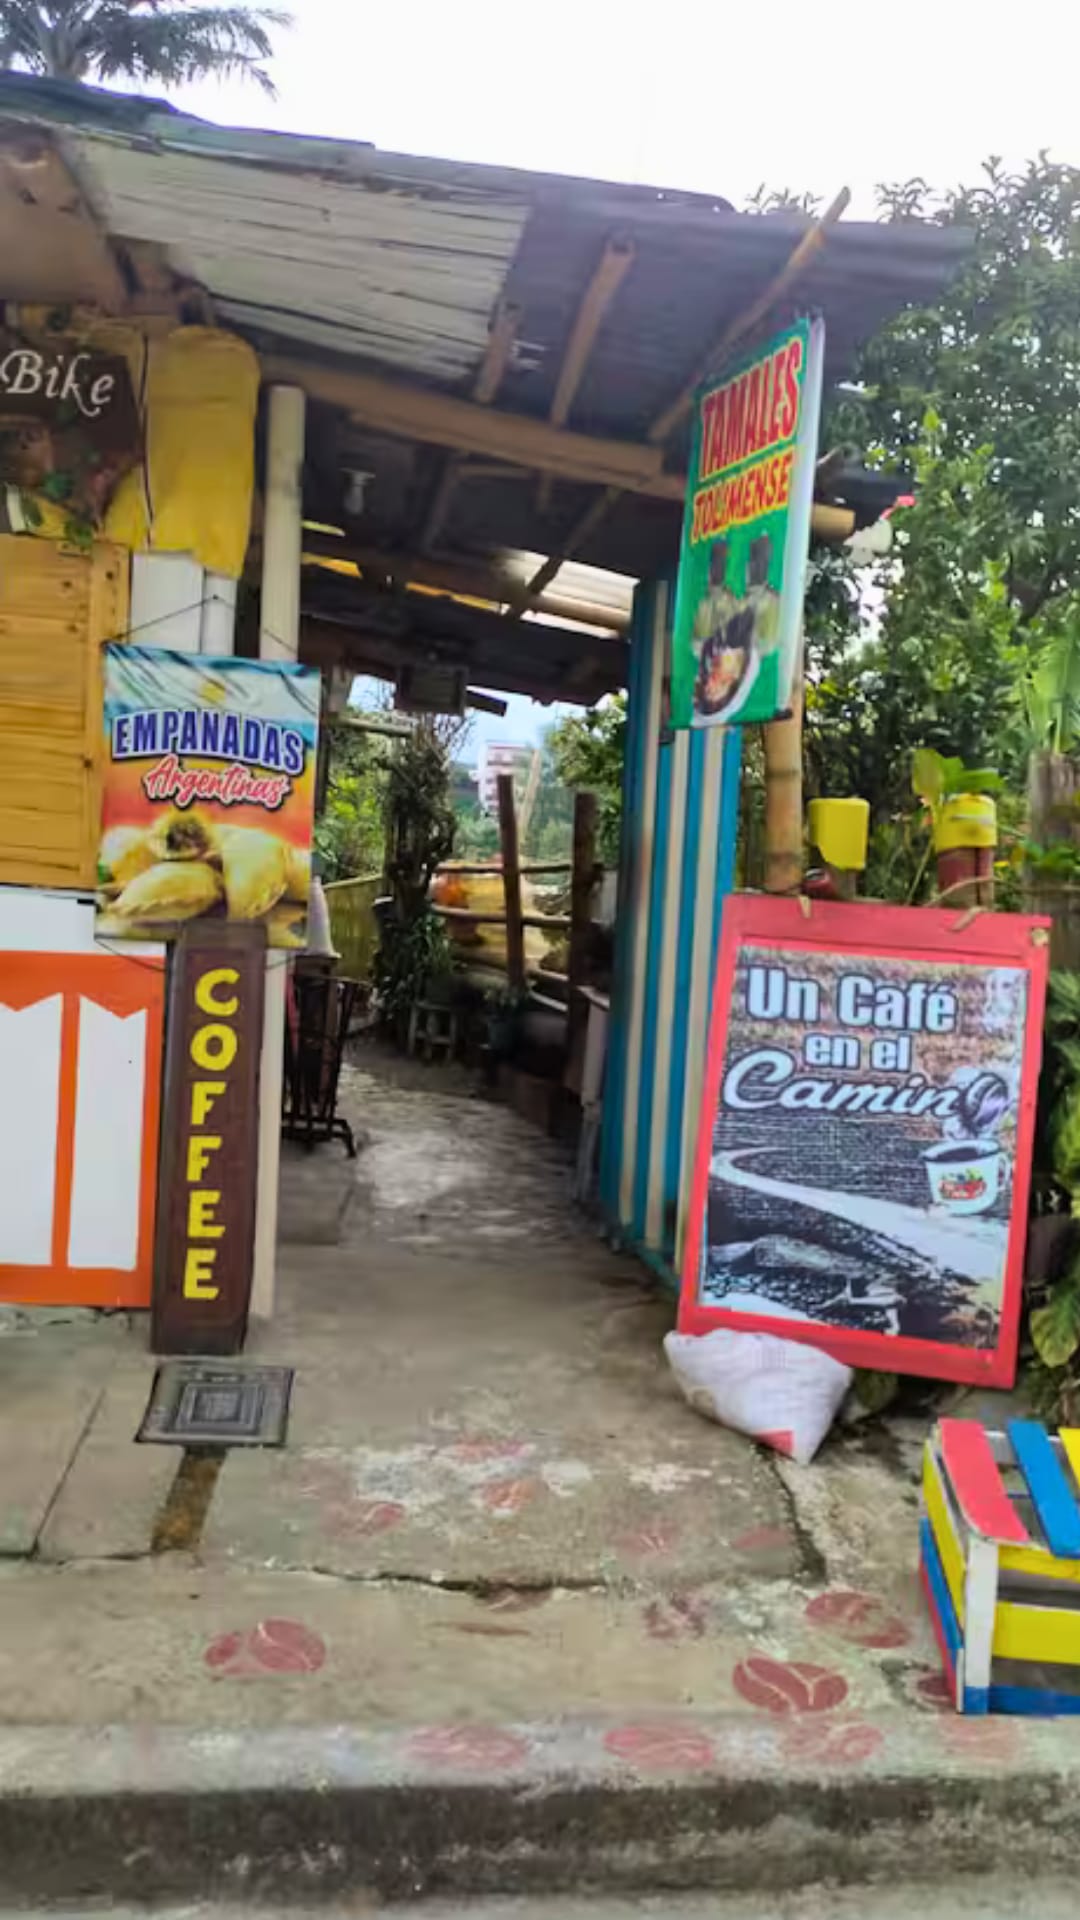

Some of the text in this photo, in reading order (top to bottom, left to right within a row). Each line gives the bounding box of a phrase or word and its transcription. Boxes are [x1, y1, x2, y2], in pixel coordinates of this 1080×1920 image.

[0, 349, 115, 417] Bike
[700, 338, 803, 481] TAMALES
[691, 444, 796, 545] TOLIMENSE
[114, 709, 304, 774] EMPANADAS
[146, 754, 290, 808] Argentinas
[747, 967, 959, 1033] Un Café
[805, 1033, 913, 1073] en el
[182, 967, 241, 1300] COFFEE
